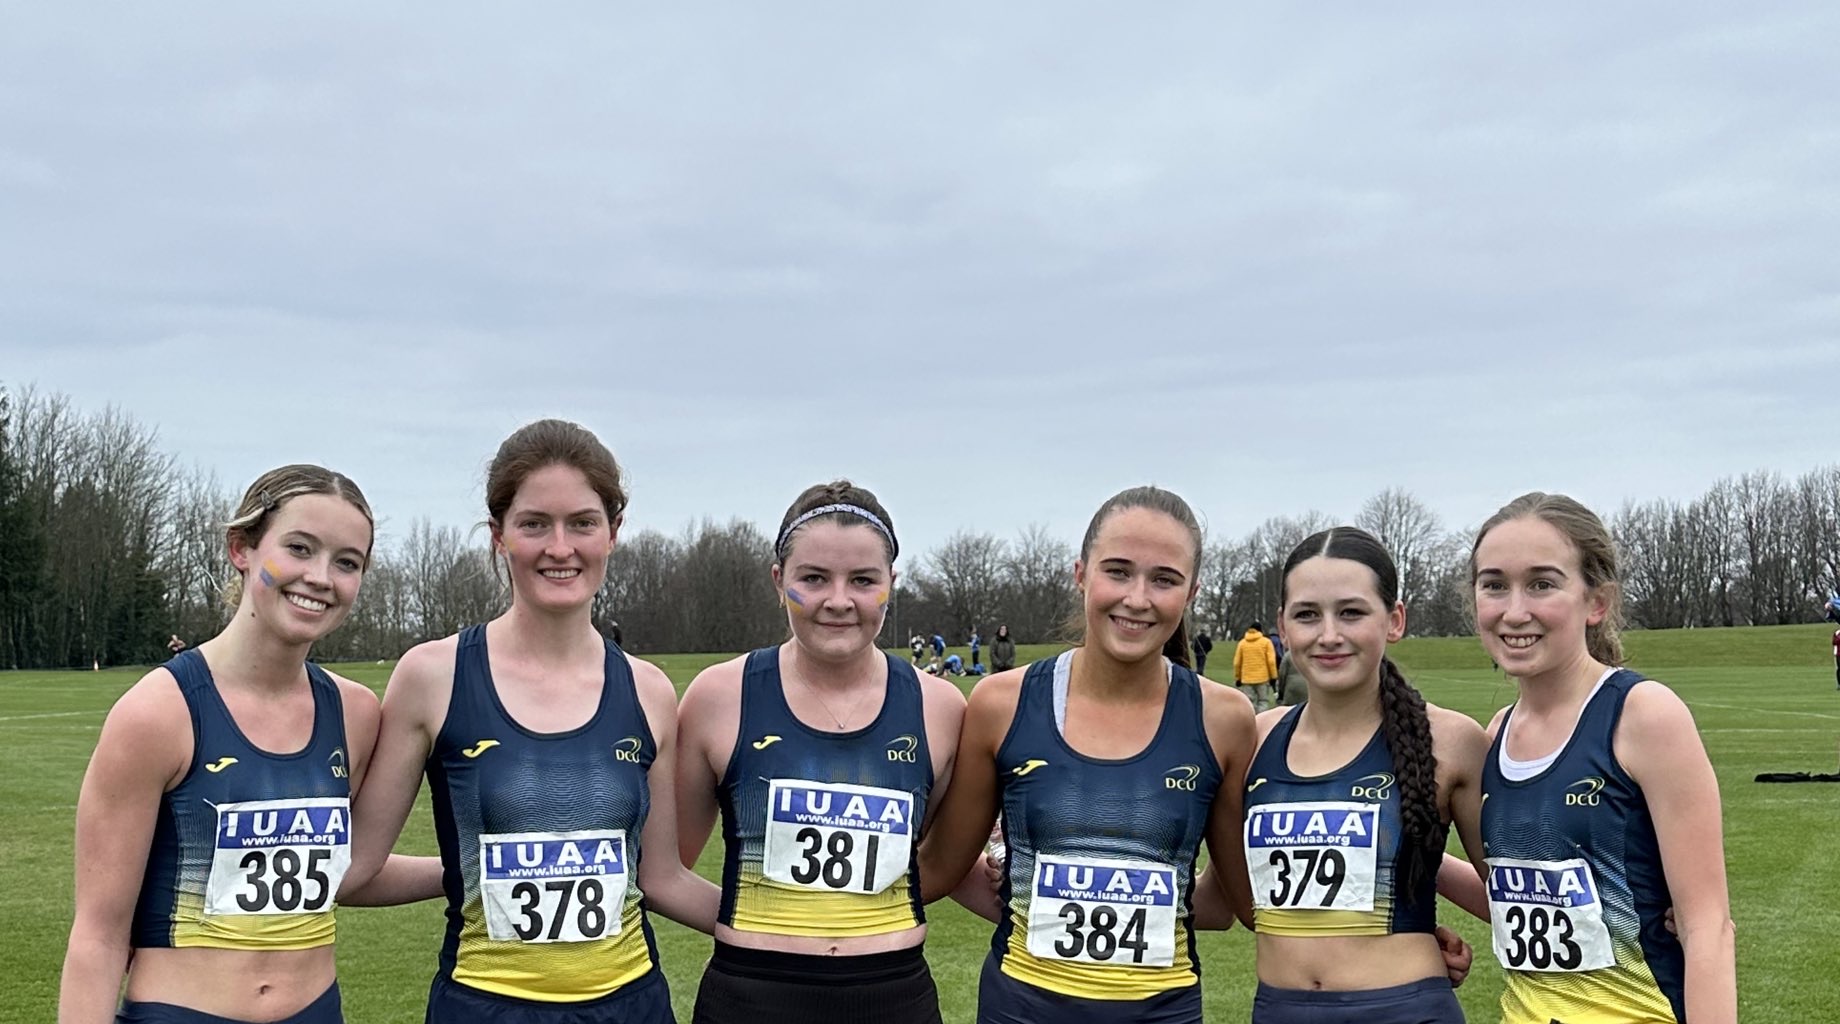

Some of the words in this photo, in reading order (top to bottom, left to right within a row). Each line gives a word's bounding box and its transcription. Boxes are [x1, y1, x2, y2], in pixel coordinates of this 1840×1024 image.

[615, 749, 640, 763] DCU
[887, 750, 916, 762] DCU
[1165, 777, 1196, 791] DCU
[1351, 785, 1390, 800] DCU
[1565, 793, 1600, 807] DCU
[796, 813, 890, 832] www.iuaa.org
[241, 833, 336, 846] www.iuaa.org
[1264, 834, 1351, 846] www.iuaa.org
[790, 828, 880, 892] 381
[509, 864, 606, 877] www.iuaa.org
[1269, 848, 1346, 907] 379
[236, 848, 331, 912] 385
[1058, 887, 1155, 905] www.iuaa.org
[511, 878, 606, 940] 378
[1054, 902, 1149, 963] 384
[1505, 905, 1583, 970] 383
